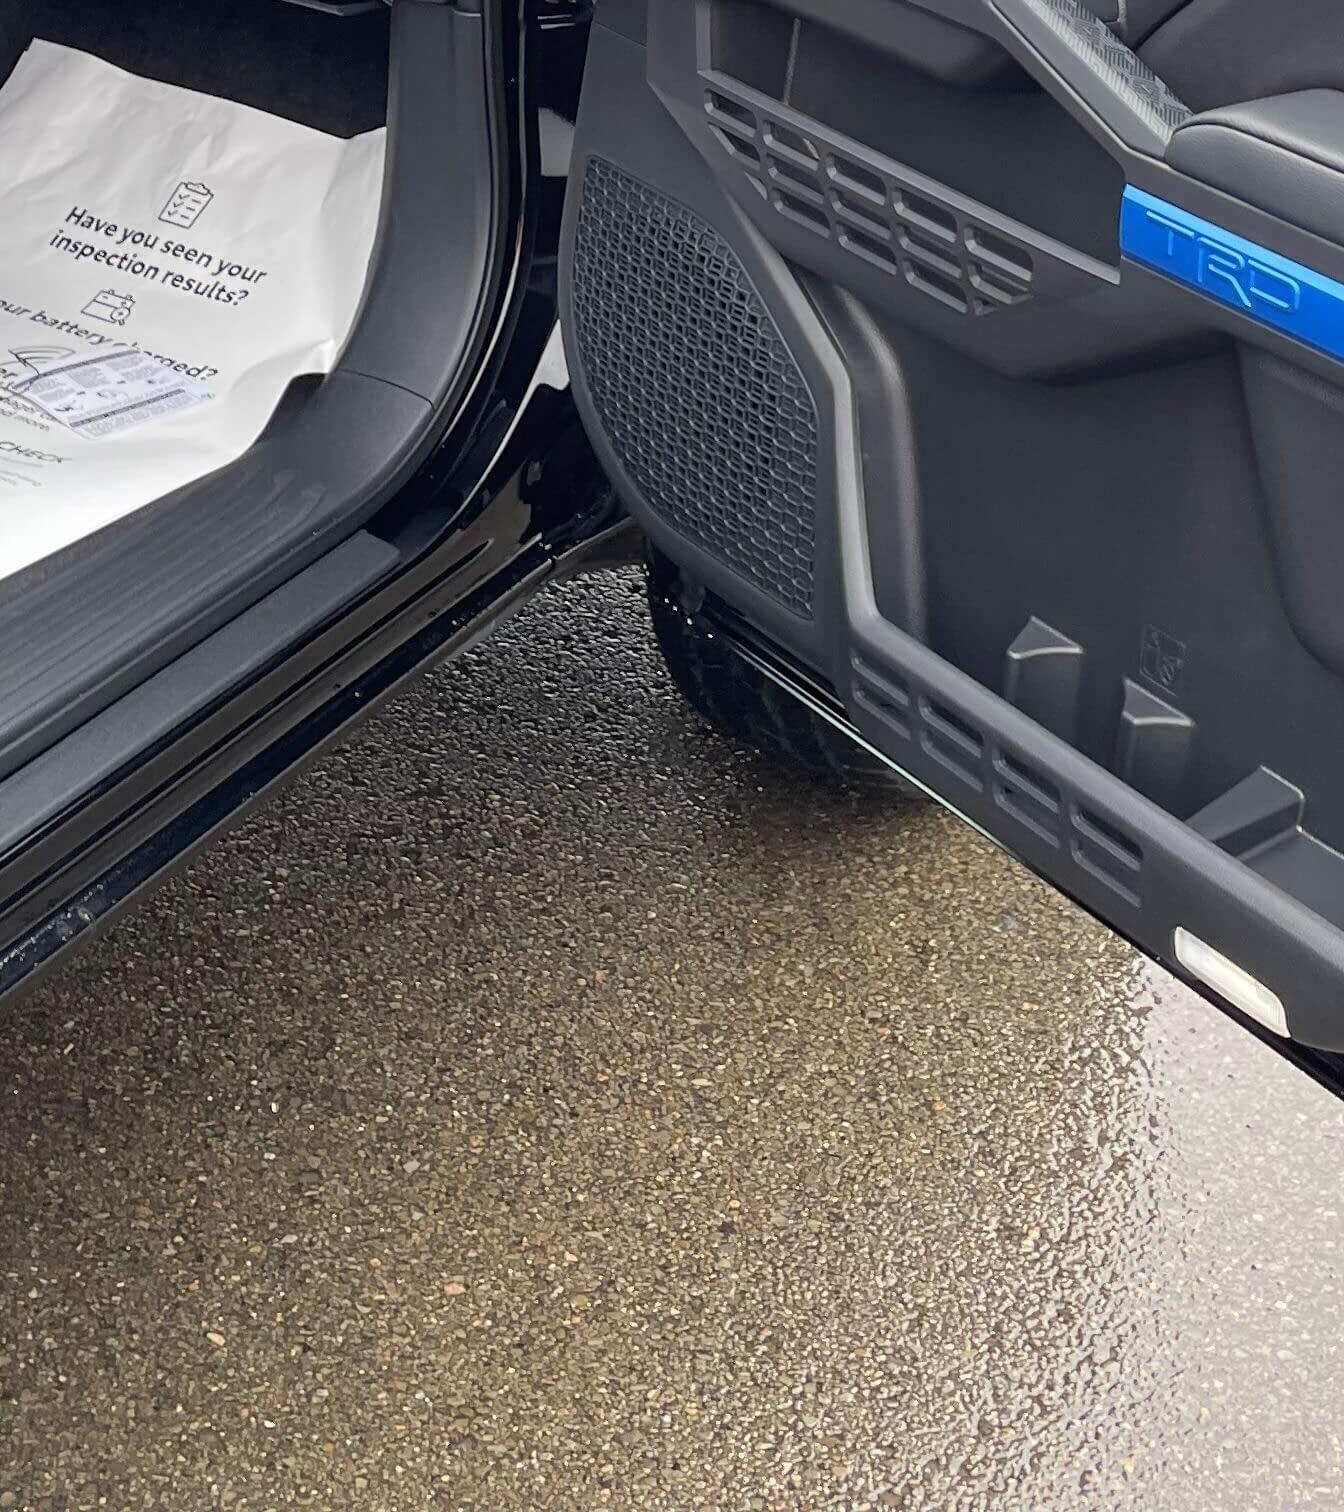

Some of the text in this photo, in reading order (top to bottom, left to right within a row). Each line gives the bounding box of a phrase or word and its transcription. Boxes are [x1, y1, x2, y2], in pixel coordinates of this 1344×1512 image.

[49, 229, 249, 306] inspection results?
[65, 205, 268, 284] Have you seen your
[1145, 210, 1301, 314] TRD
[29, 310, 114, 345] battery
